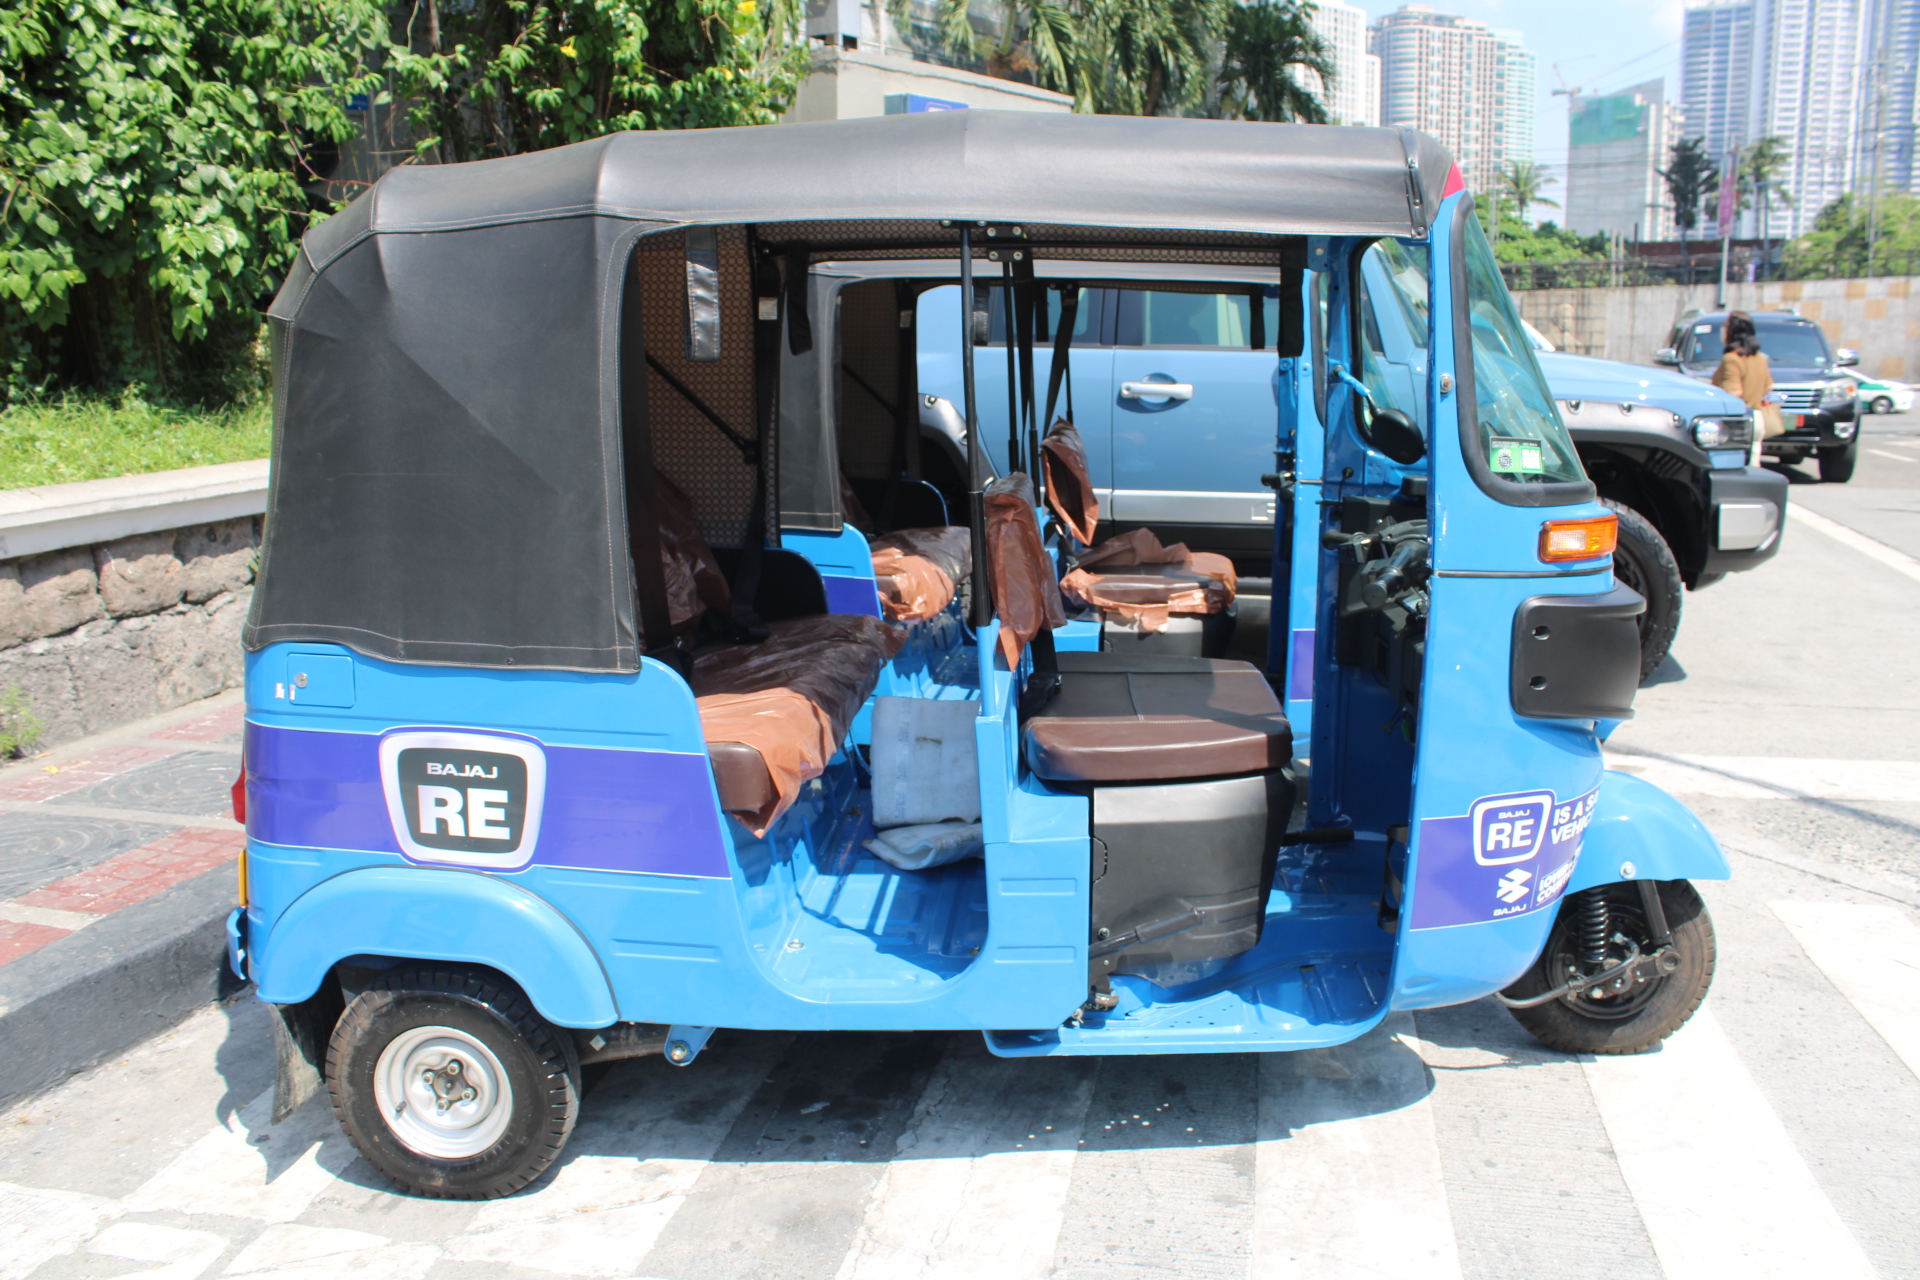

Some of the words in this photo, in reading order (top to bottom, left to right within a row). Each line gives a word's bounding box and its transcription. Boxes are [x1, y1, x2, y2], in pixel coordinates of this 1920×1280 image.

[427, 762, 498, 779] BAJAJ
[417, 784, 511, 840] RE
[1498, 809, 1530, 819] BAJAJ
[1553, 805, 1571, 826] IS
[1571, 800, 1583, 820] A
[1486, 818, 1535, 851] RE
[1493, 903, 1527, 916] BAJAJ
